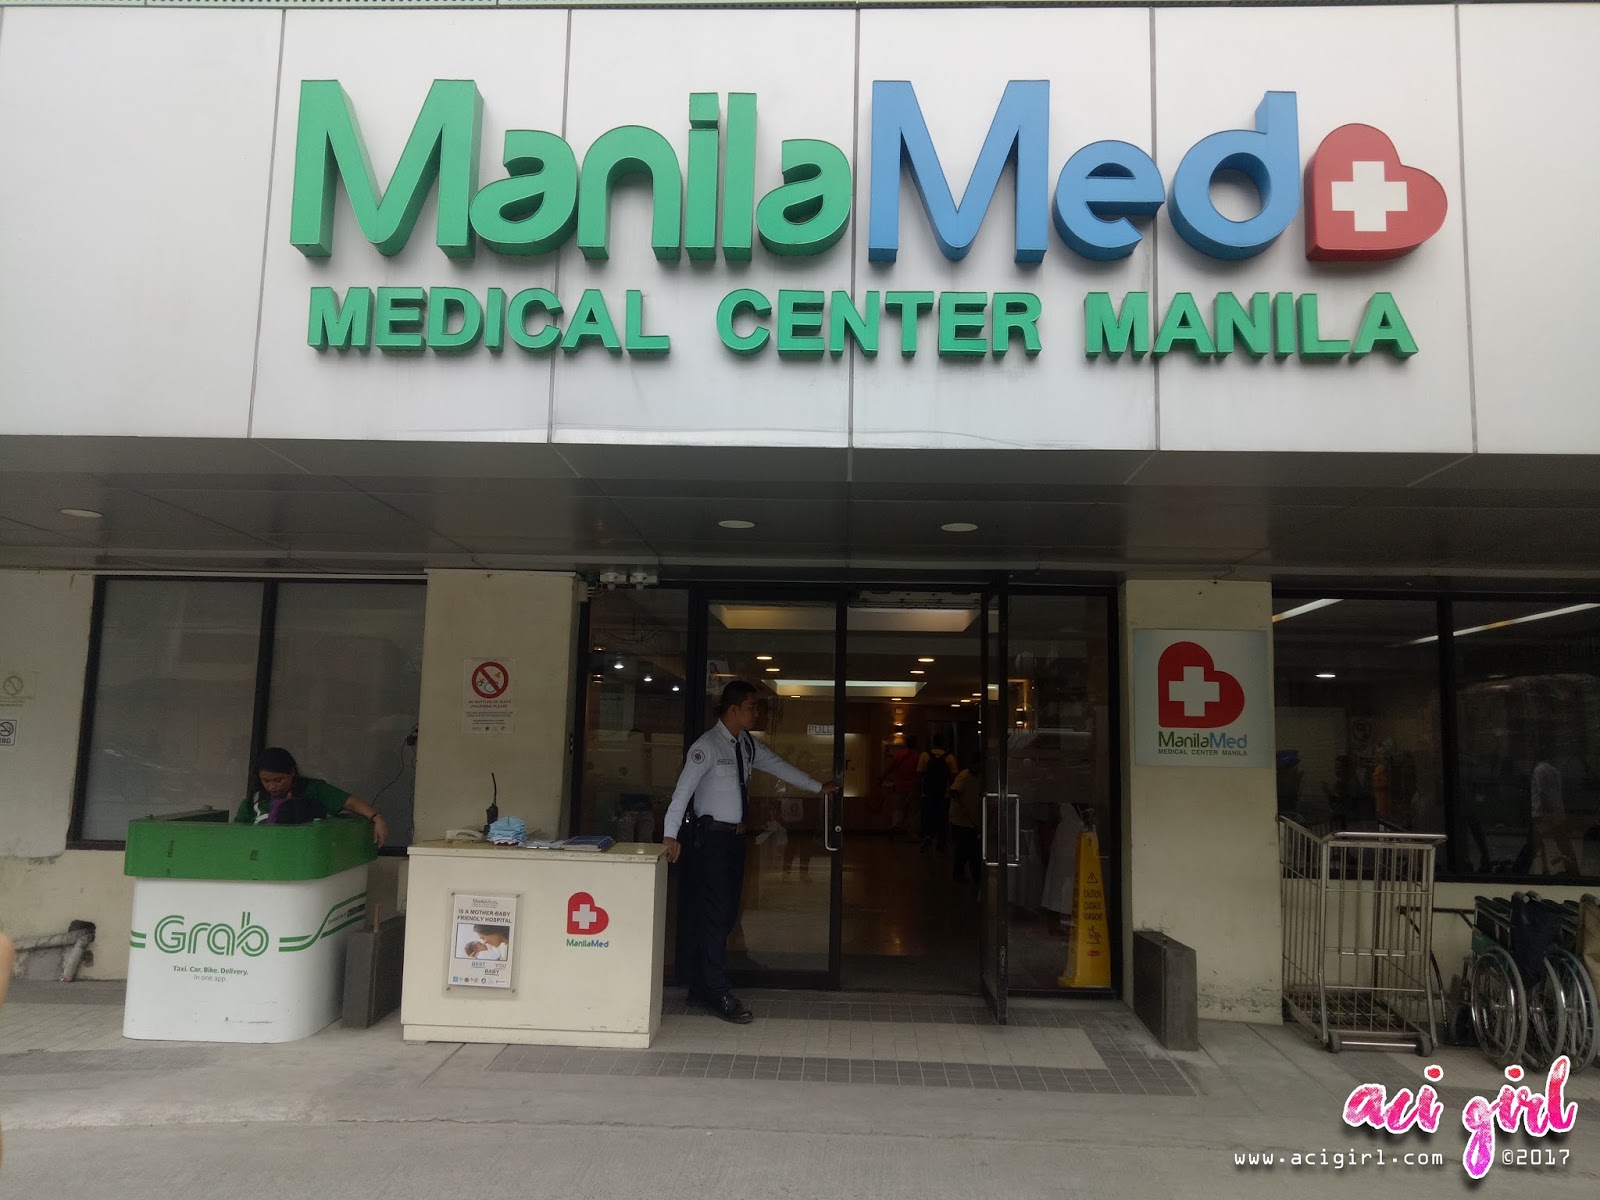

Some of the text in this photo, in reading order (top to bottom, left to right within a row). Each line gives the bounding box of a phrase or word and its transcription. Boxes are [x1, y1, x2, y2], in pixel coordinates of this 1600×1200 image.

[290, 78, 1300, 263] ManilaMed
[307, 286, 1419, 360] MEDICAL CENTER MANILA
[808, 725, 832, 733] PULL
[1158, 731, 1248, 749] ManilaMed
[154, 911, 269, 957] Grab
[566, 938, 609, 948] ManilaMed
[203, 966, 219, 974] Bike.
[220, 967, 249, 976] Delivery.
